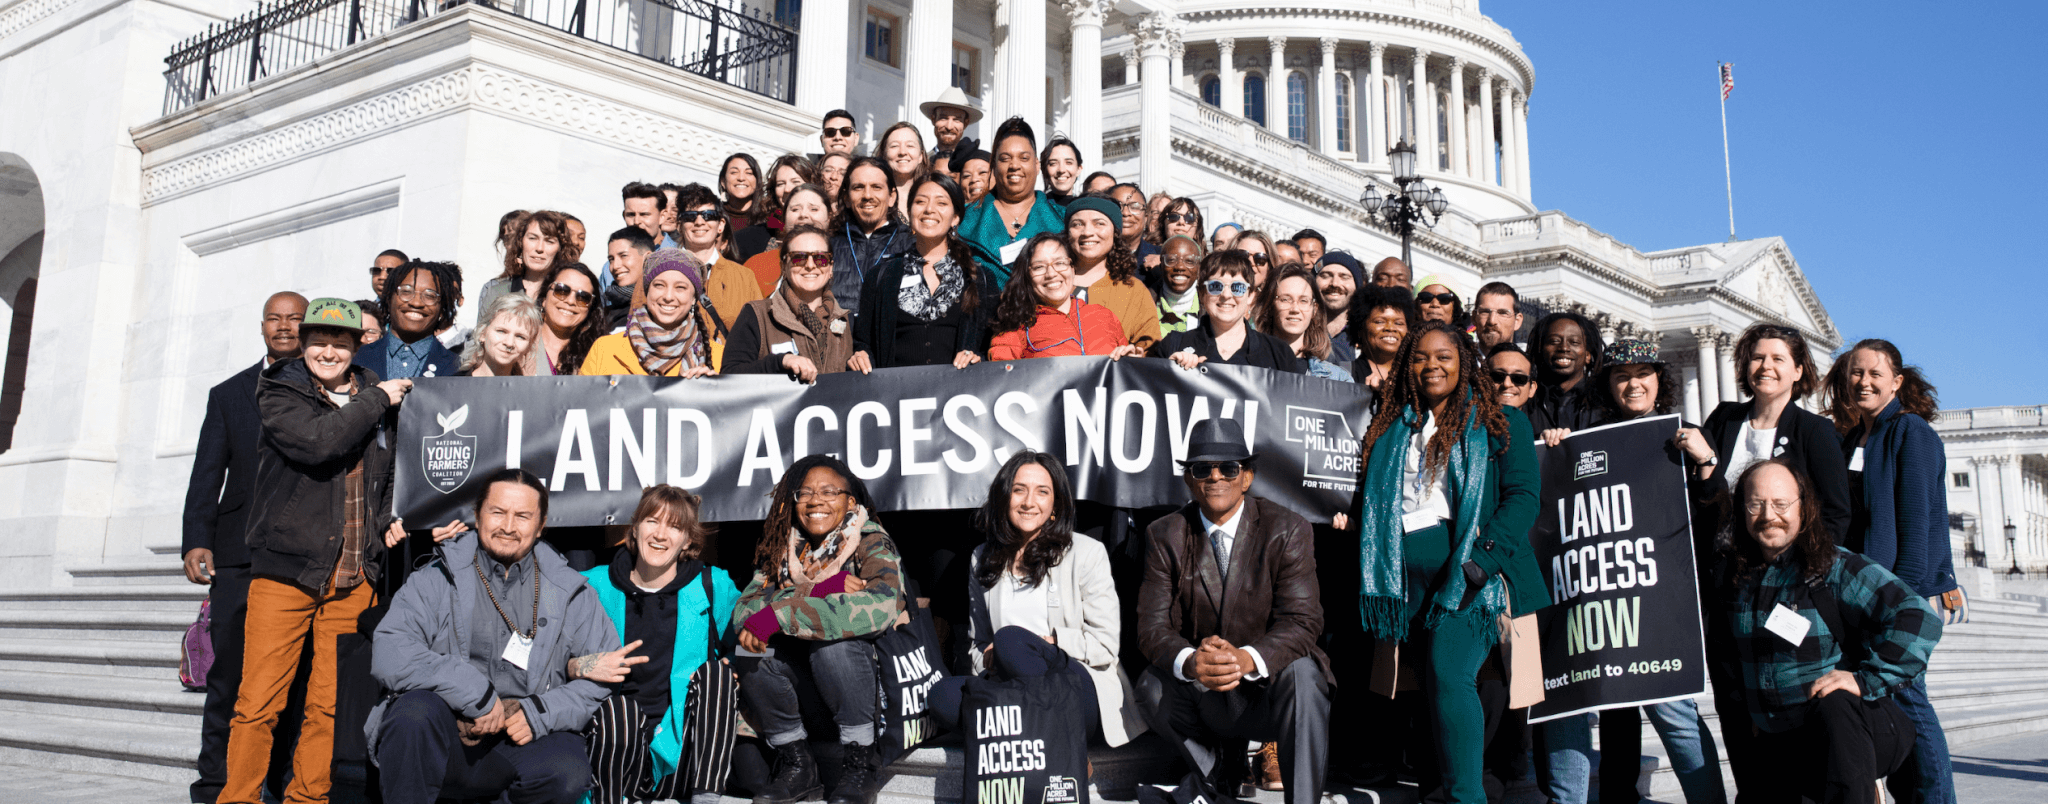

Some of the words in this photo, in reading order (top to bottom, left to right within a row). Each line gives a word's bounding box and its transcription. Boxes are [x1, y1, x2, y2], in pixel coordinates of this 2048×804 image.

[1295, 416, 1325, 434] ONE
[506, 408, 712, 491] LAND
[737, 391, 1046, 486] ACCESS
[1305, 434, 1362, 455] MILLION
[427, 446, 471, 461] YOUNG
[1580, 450, 1593, 459] ONE
[1580, 454, 1604, 465] MILLION
[428, 459, 469, 471] FARMERS
[1323, 454, 1363, 473] ACRE
[1578, 462, 1597, 472] ACRES
[1303, 480, 1318, 488] FOR
[1318, 481, 1333, 490] THE
[1558, 483, 1633, 545] LAND
[1552, 537, 1658, 606] ACCESS
[1567, 596, 1640, 656] NOW
[1544, 673, 1569, 690] text
[1571, 664, 1601, 683] land
[1604, 664, 1623, 677] to
[1627, 658, 1683, 675] 40649
[976, 705, 1023, 739] LAND
[978, 739, 1046, 775] ACCESS
[1049, 775, 1063, 783] ONE
[1049, 782, 1074, 791] MILLION
[978, 776, 1026, 804] NOW
[1046, 789, 1068, 798] ACRES
